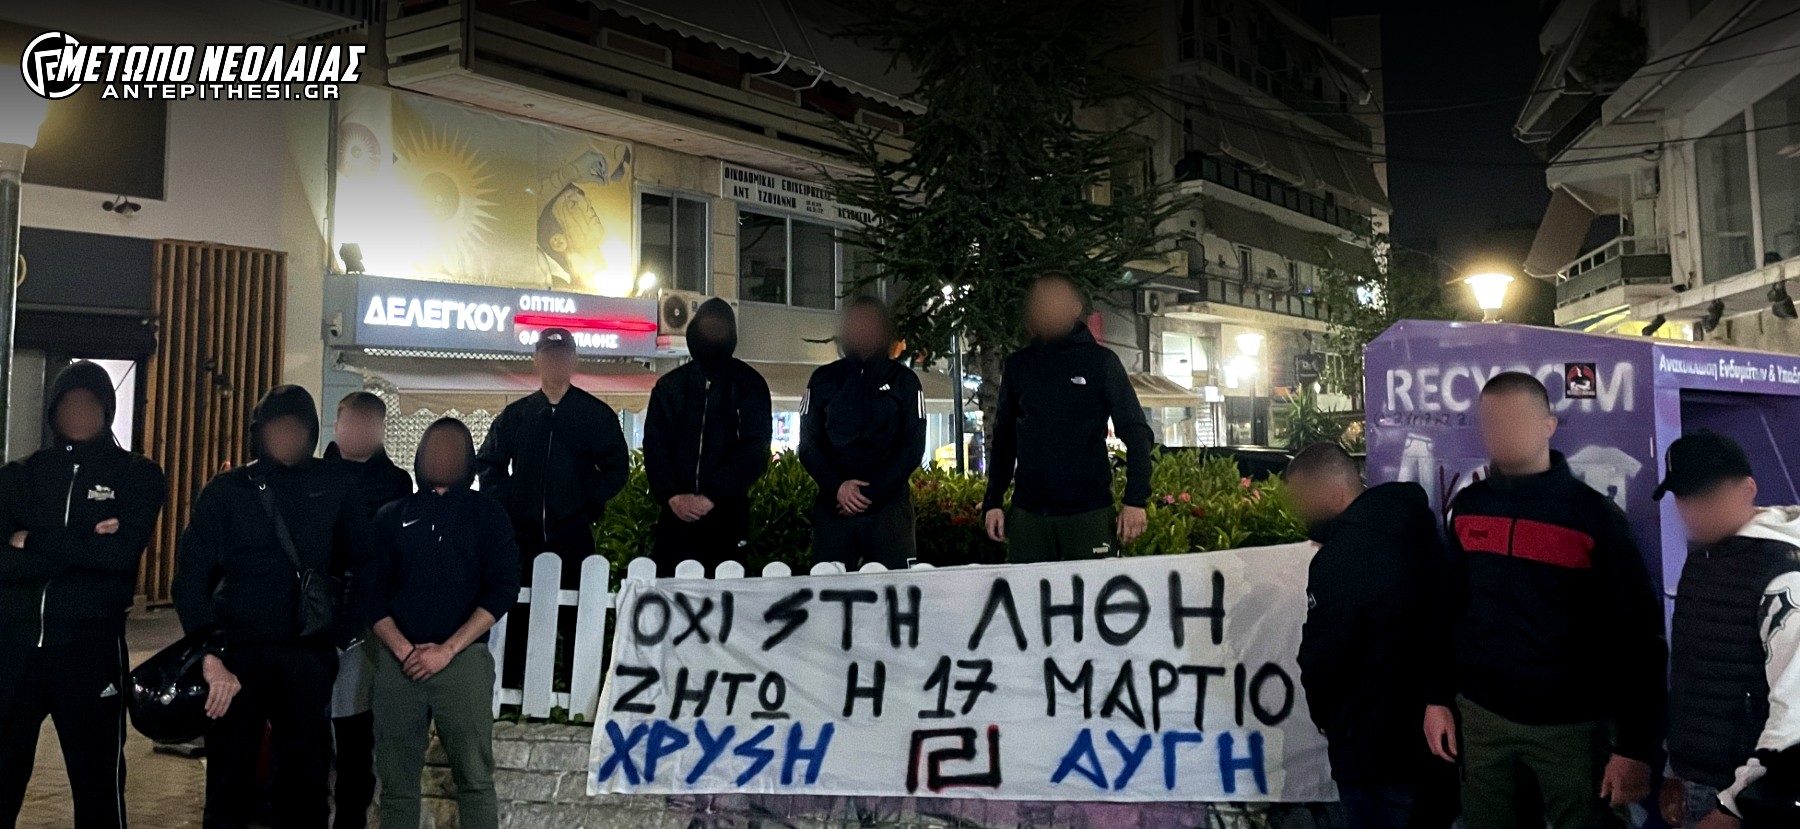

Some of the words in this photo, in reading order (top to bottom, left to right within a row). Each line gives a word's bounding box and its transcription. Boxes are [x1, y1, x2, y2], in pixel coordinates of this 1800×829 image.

[363, 295, 511, 332] ΔΕΛΕΓΚΟΥ
[519, 294, 576, 314] ΟΠΤΙΚΑ
[632, 590, 734, 647] ΟΧΙ
[968, 569, 1226, 651] ΛΗΘΗ
[843, 660, 886, 718] Η
[918, 655, 997, 718] 17
[1044, 657, 1295, 732] ΜΑΡΤΙΟ
[1051, 728, 1268, 795] ΑΥΓΗ
